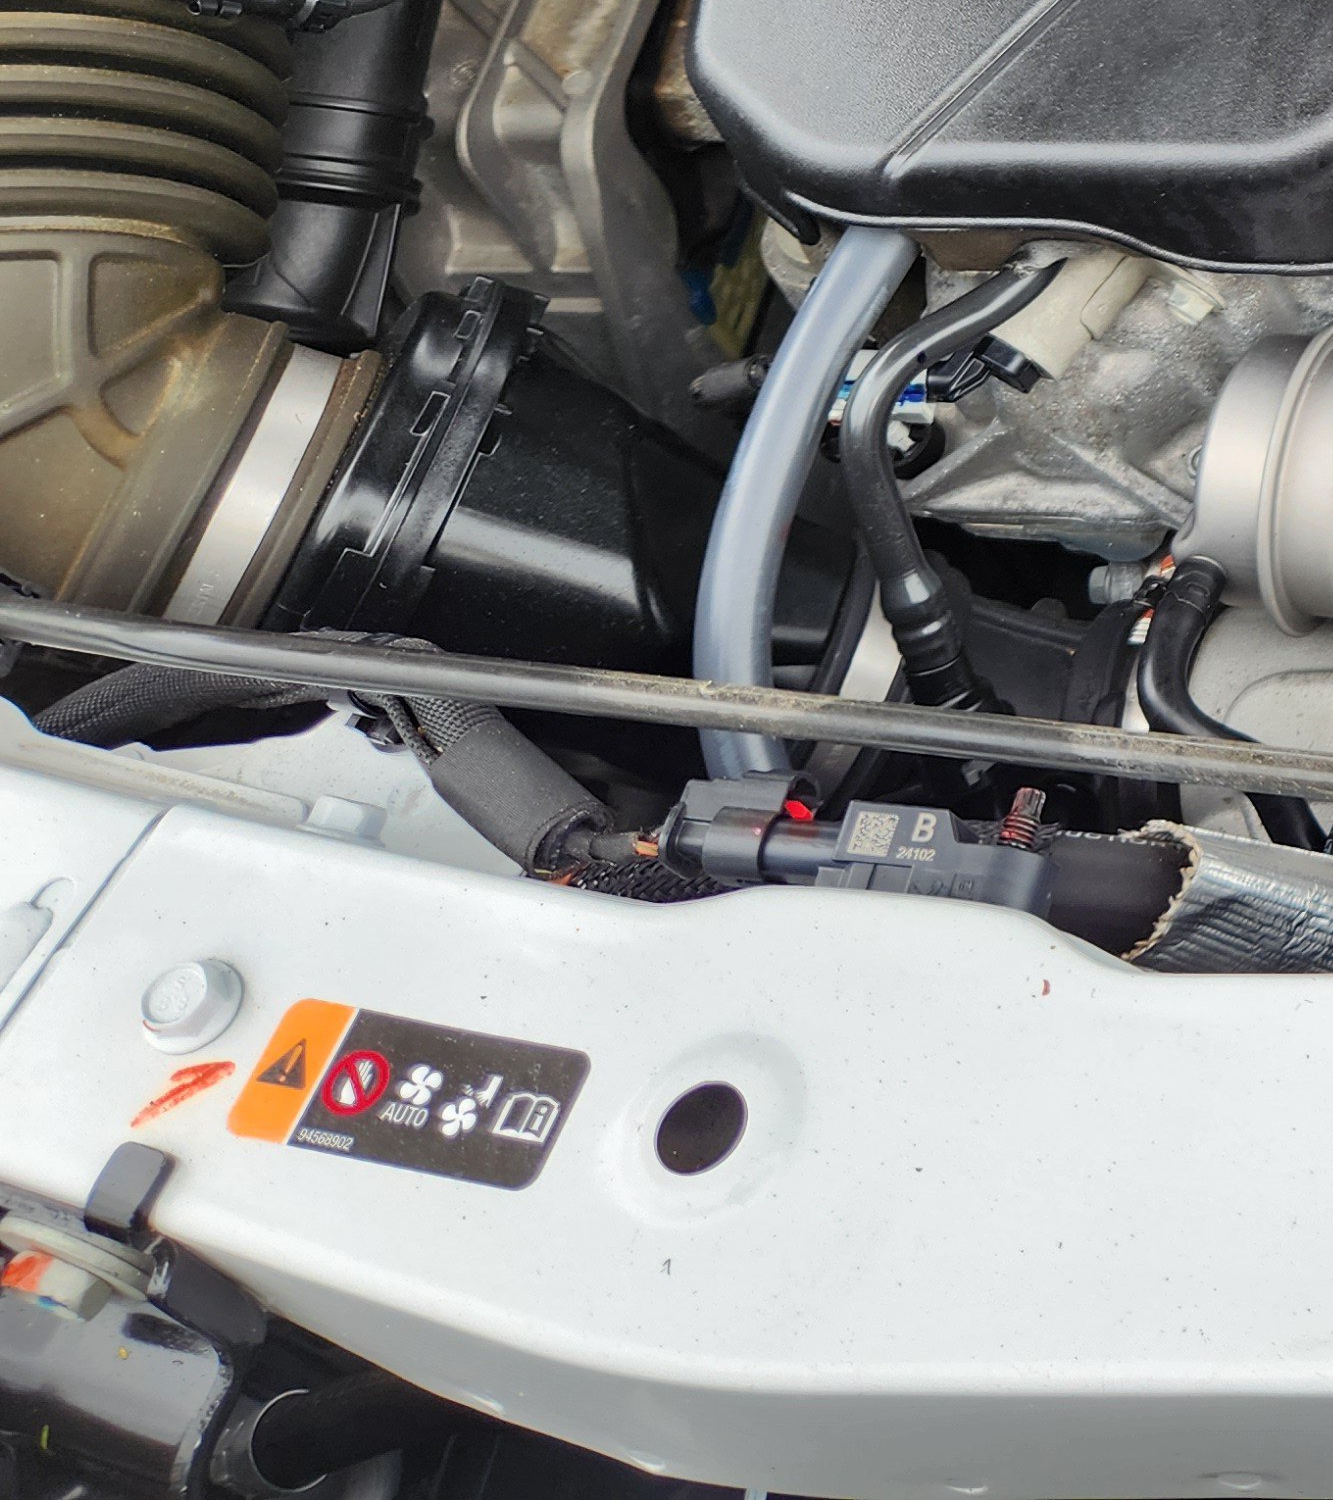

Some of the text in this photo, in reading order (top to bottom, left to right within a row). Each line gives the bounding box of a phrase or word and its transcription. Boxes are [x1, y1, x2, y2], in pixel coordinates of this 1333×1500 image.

[911, 811, 938, 843] B
[896, 845, 936, 862] 24102
[380, 1102, 428, 1128] AUTO
[297, 1128, 354, 1150] 94568902
